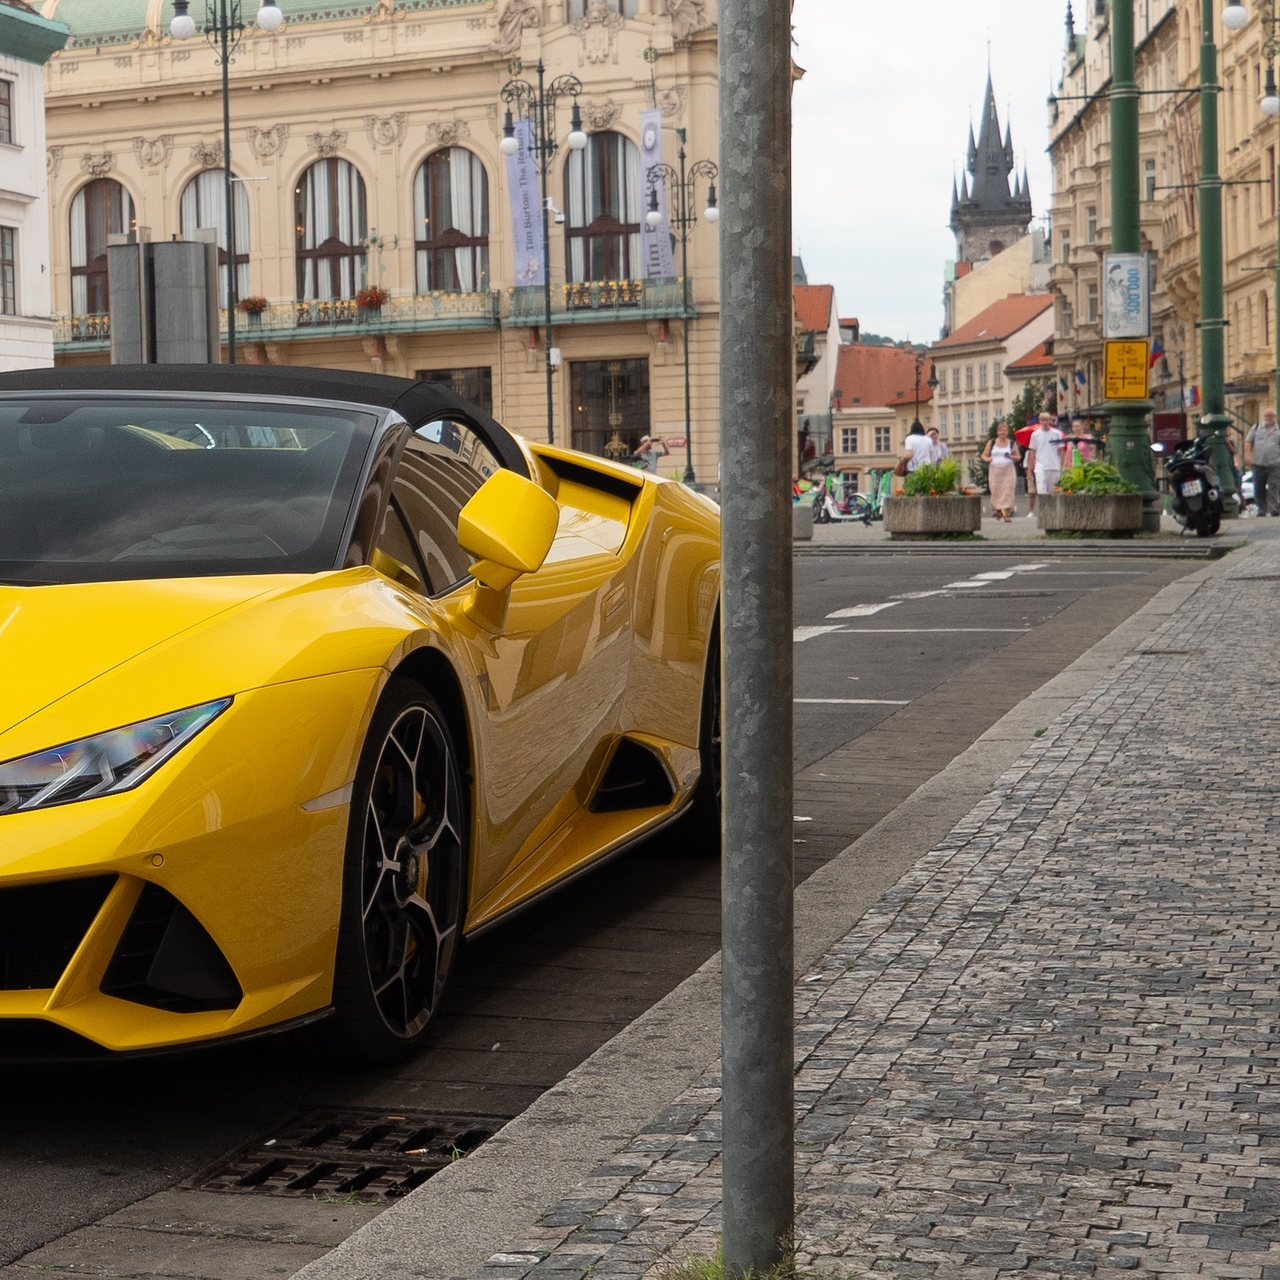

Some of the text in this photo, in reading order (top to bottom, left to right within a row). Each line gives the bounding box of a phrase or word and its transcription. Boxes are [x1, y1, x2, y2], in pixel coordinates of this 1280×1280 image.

[517, 129, 534, 251] Tim Burton: The Return
[646, 244, 661, 278] Tim
